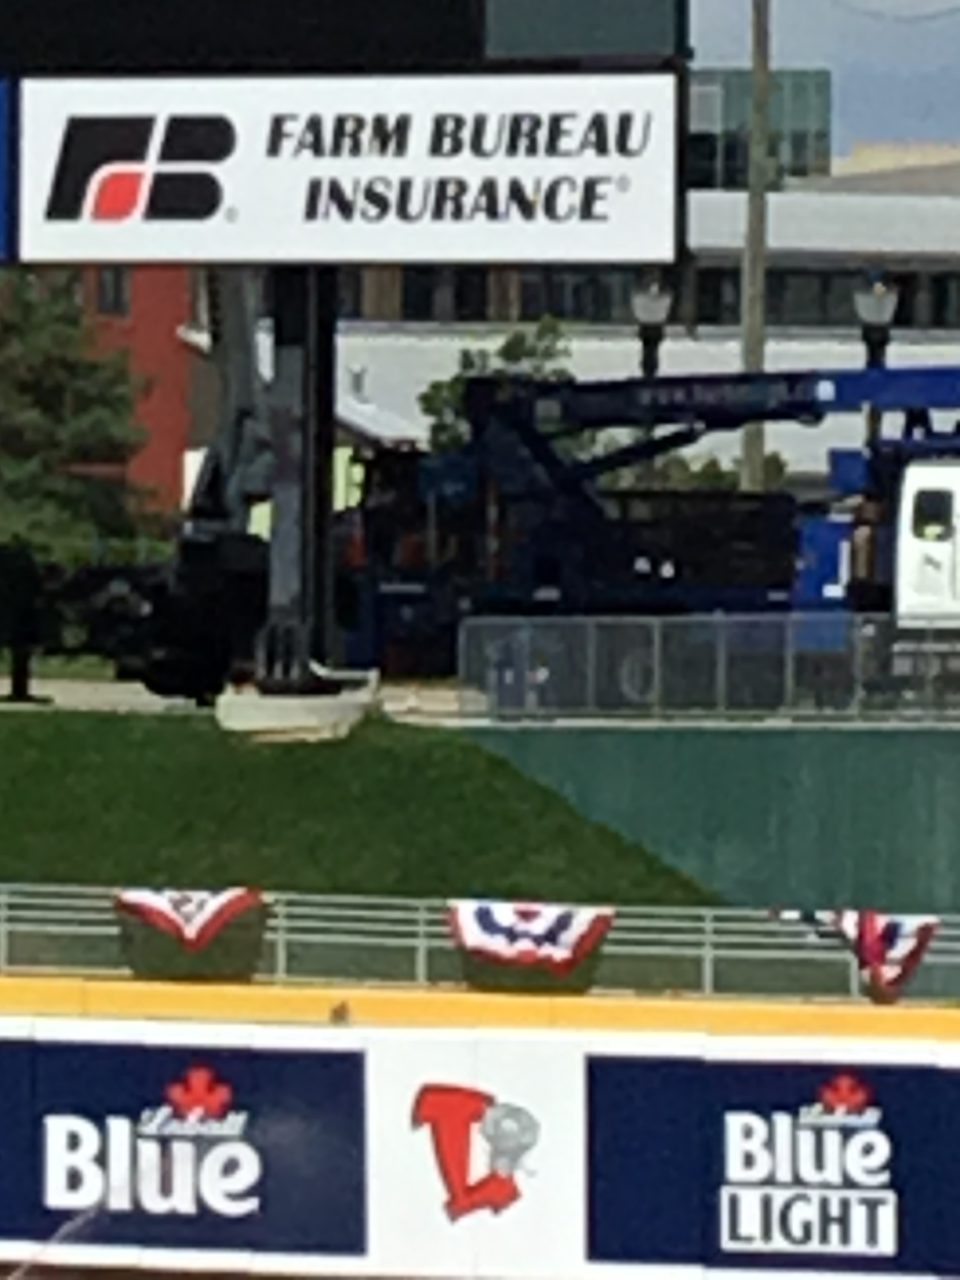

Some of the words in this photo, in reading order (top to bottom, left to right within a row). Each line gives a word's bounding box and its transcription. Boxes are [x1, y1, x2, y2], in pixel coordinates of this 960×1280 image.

[265, 113, 410, 160] FARM
[427, 111, 652, 158] BUREAU
[303, 175, 612, 223] INSURANCE
[43, 1114, 261, 1217] Blue
[723, 1111, 891, 1186] Blue
[727, 1192, 890, 1249] LIGHT
